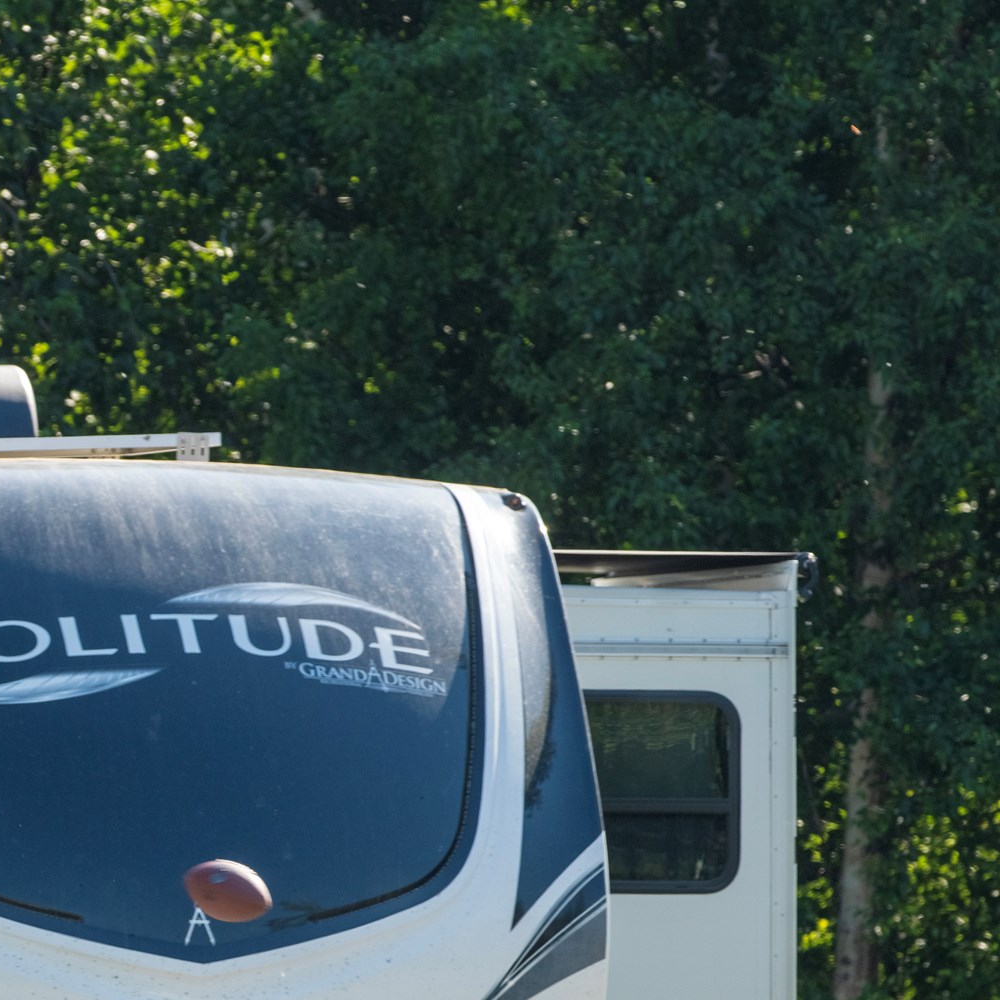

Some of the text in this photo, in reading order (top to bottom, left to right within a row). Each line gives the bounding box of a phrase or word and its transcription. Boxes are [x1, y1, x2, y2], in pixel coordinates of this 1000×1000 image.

[284, 661, 297, 670] BY
[298, 662, 368, 683] GRAND
[383, 671, 447, 693] DESIGN
